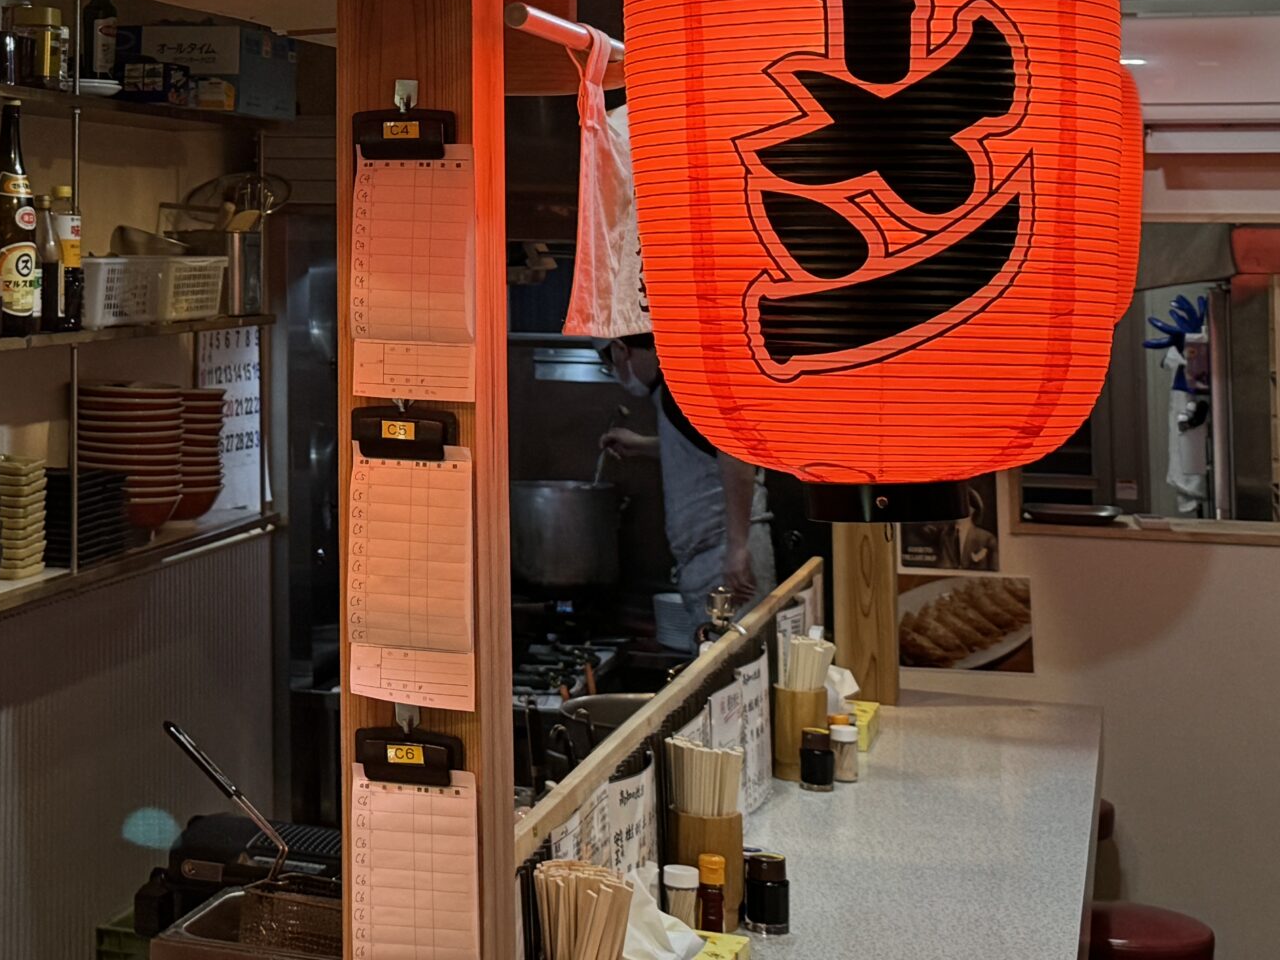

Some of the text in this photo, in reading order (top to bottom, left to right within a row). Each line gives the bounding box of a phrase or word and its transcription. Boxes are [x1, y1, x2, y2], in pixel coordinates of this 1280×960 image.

[157, 42, 216, 54] オールタイム
[389, 123, 410, 137] C4
[215, 332, 221, 350] 5
[224, 331, 230, 349] 6
[235, 330, 240, 348] 7
[245, 329, 250, 347] 8
[214, 367, 222, 384] 12
[224, 366, 232, 383] 13
[234, 365, 242, 382] 14
[243, 363, 251, 381] 15
[235, 399, 243, 416] 21
[245, 398, 253, 415] 22
[387, 423, 407, 436] C5
[225, 435, 234, 452] 27
[235, 433, 244, 451] 28
[245, 431, 254, 449] 29
[394, 747, 415, 760] C6
